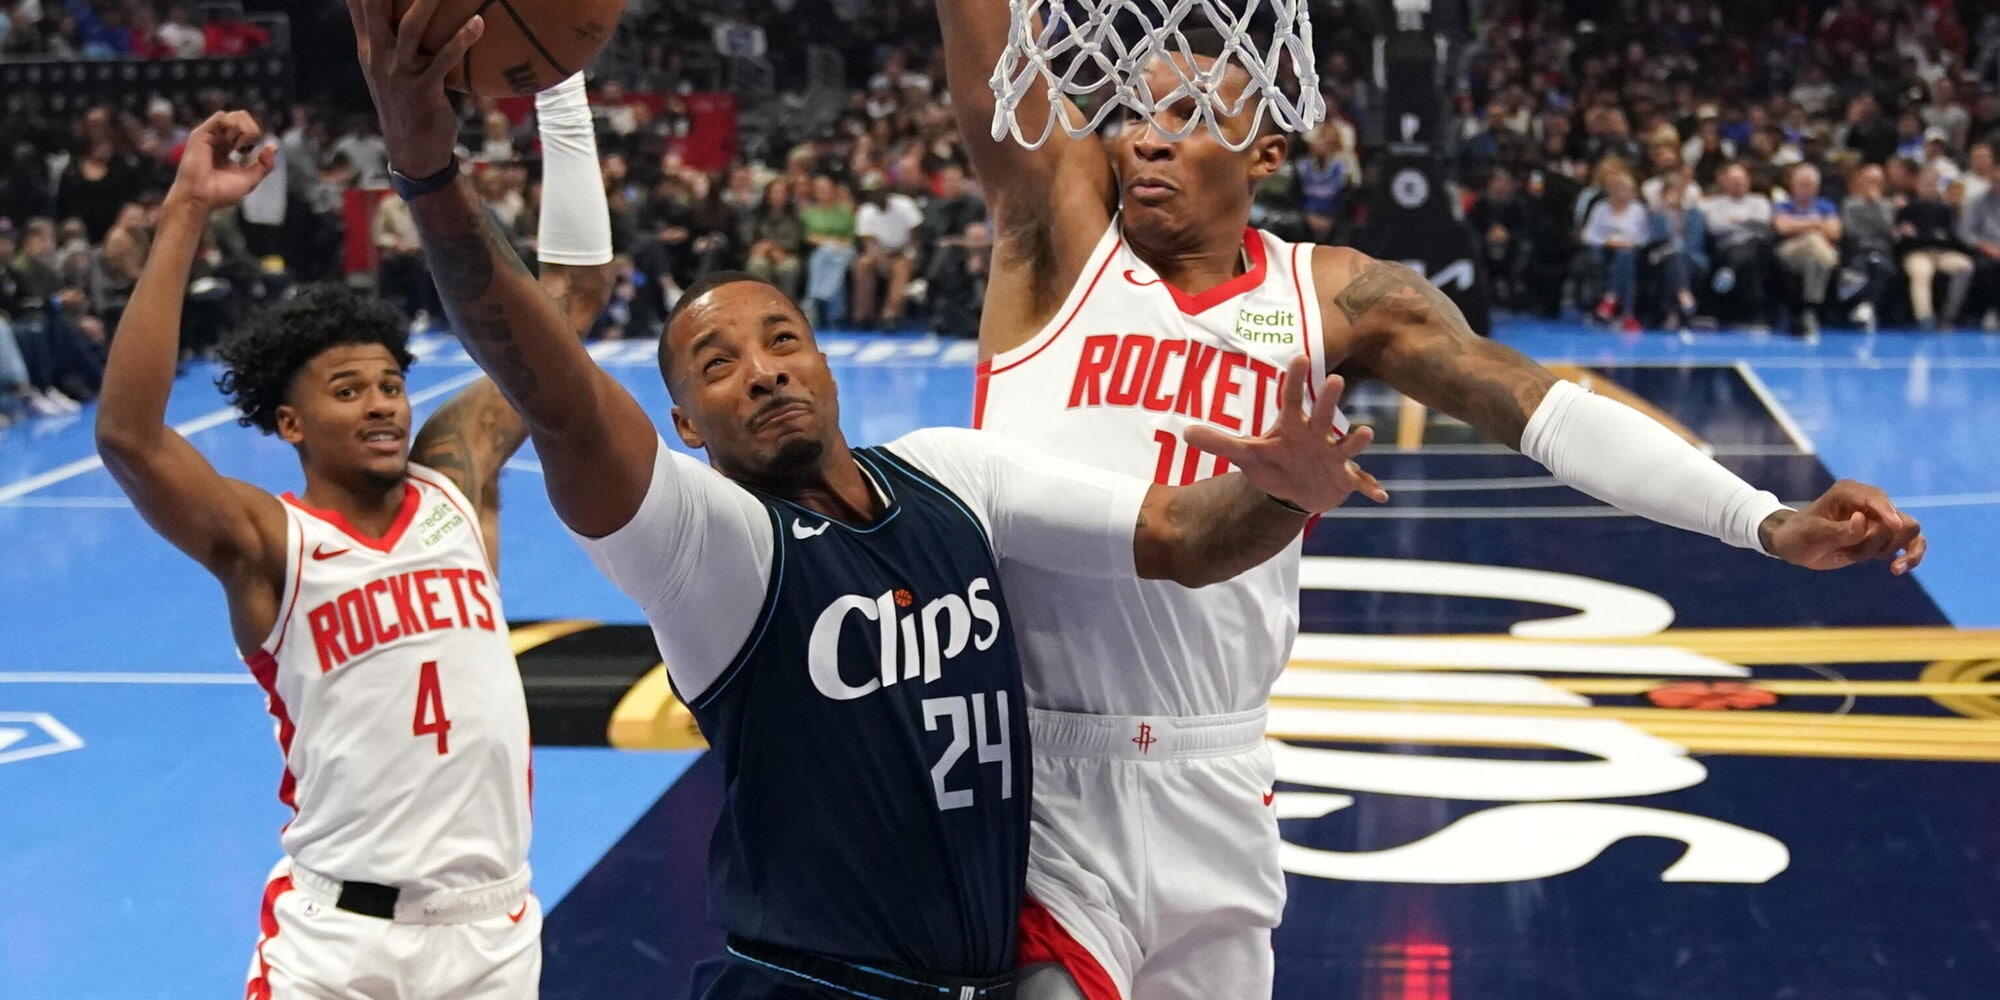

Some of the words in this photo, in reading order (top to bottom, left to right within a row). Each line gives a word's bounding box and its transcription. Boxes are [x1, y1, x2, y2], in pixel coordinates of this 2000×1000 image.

[1235, 319, 1294, 344] karma
[1240, 309, 1294, 327] credit
[1065, 333, 1286, 438] ROCKET
[308, 568, 496, 674] ROCKETS
[808, 577, 1000, 700] Clips
[413, 660, 452, 756] 4
[921, 689, 1012, 812] 24
